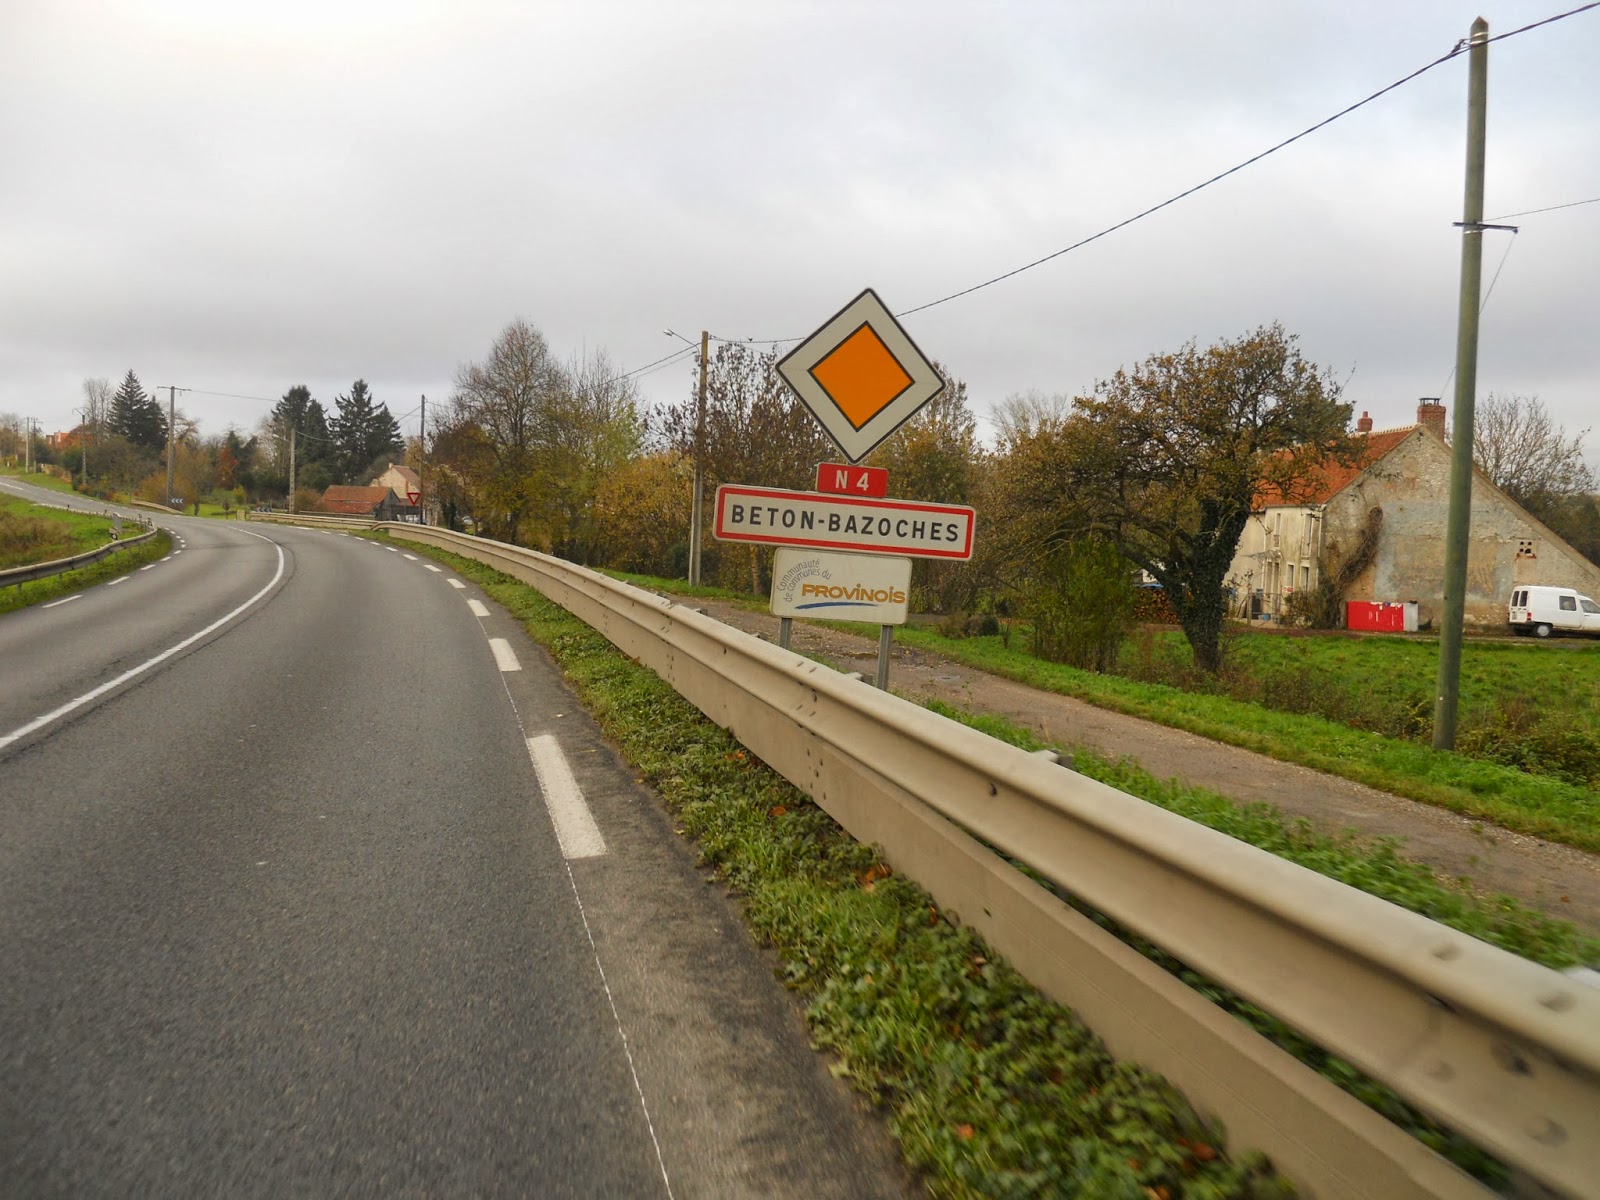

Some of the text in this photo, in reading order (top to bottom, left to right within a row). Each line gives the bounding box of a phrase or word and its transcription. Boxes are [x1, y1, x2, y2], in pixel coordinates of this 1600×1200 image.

[835, 469, 870, 491] N 4
[731, 504, 959, 542] BETON-BAZOCHES
[777, 559, 820, 591] Communauté
[783, 568, 832, 603] de communes du
